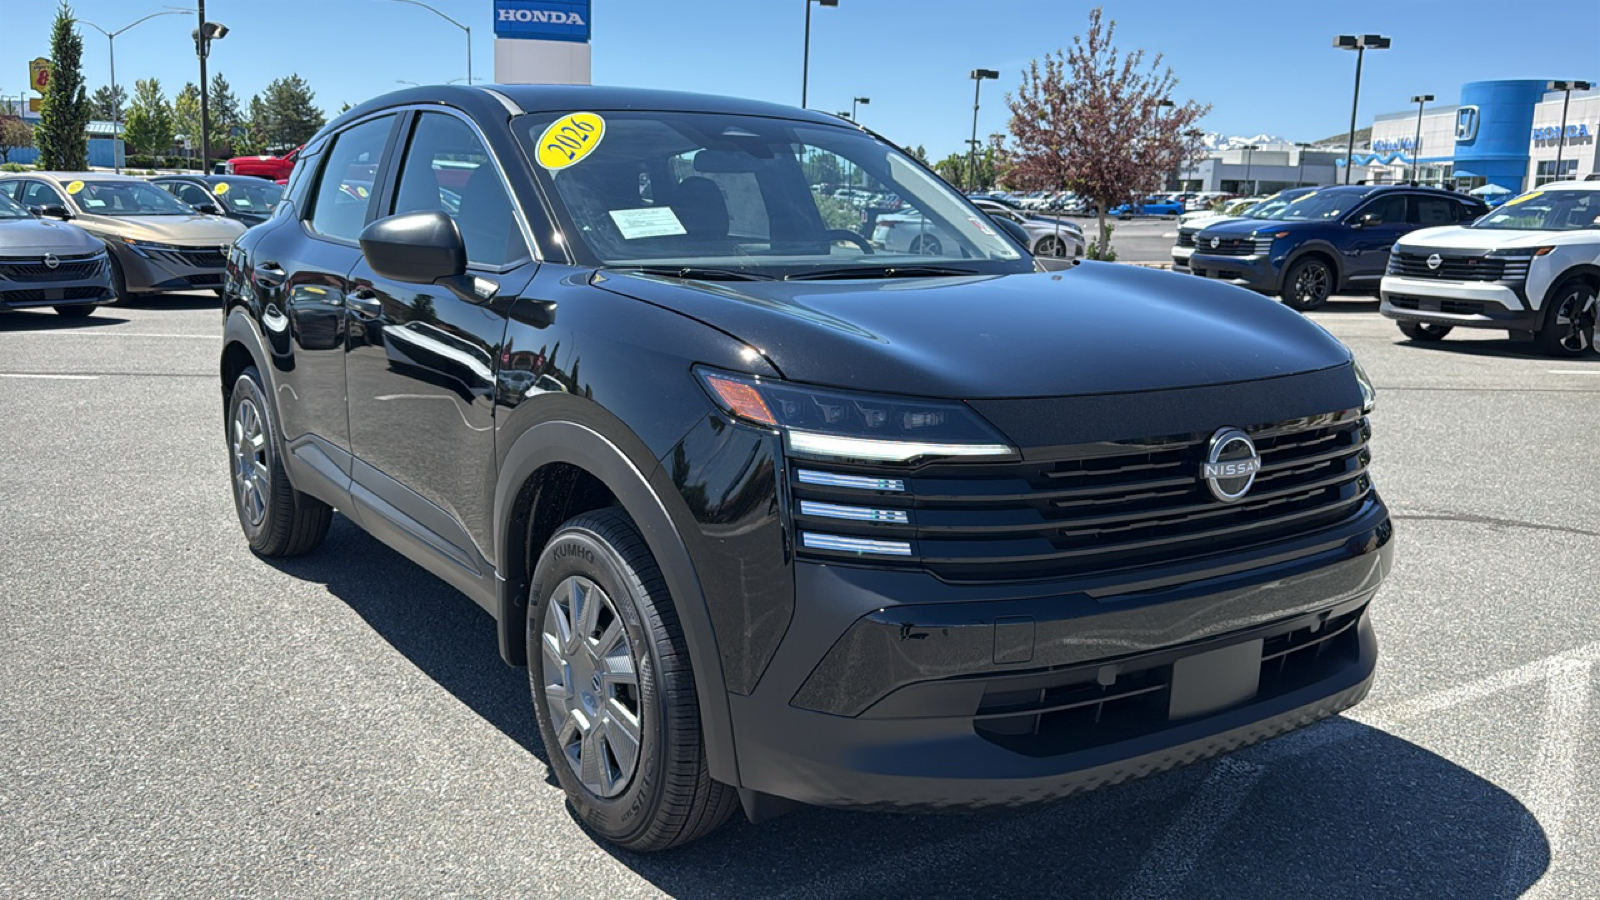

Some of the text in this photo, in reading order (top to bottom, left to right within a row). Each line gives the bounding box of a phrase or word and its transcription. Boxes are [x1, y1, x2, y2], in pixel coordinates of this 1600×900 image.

[498, 9, 586, 26] HONDA
[547, 117, 595, 161] 2026
[1532, 123, 1590, 140] HONDA
[1206, 458, 1261, 476] NISSAN
[553, 544, 595, 564] KUMHO
